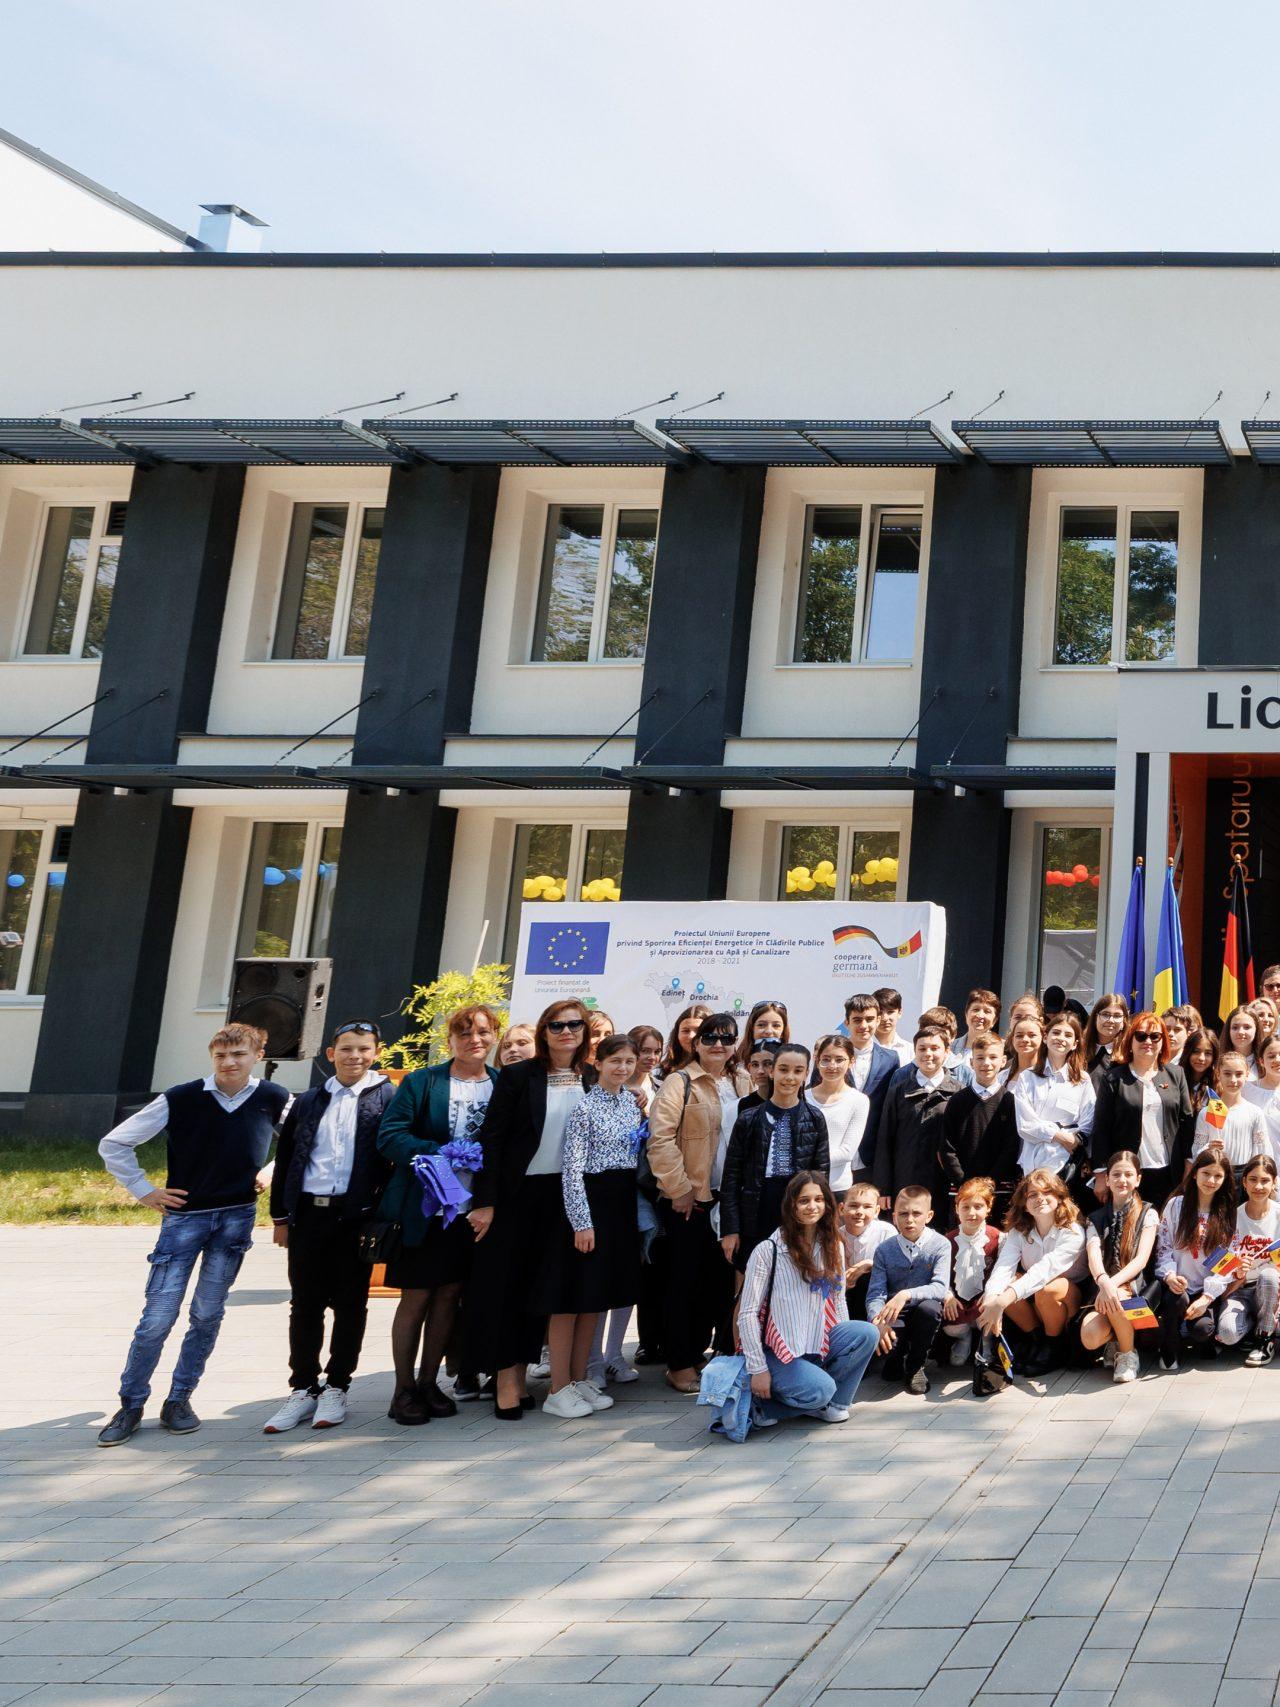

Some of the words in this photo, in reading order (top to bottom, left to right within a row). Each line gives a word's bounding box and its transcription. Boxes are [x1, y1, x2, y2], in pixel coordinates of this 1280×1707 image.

[736, 930, 771, 938] Europene
[616, 940, 643, 948] privind
[714, 940, 754, 948] Energetice
[658, 949, 713, 957] Aprovizionarea
[726, 949, 740, 957] Apă
[697, 957, 716, 965] 2018
[722, 957, 740, 965] 2021
[834, 954, 872, 962] cooperare
[832, 961, 878, 973] germană
[661, 989, 685, 999] Edineț
